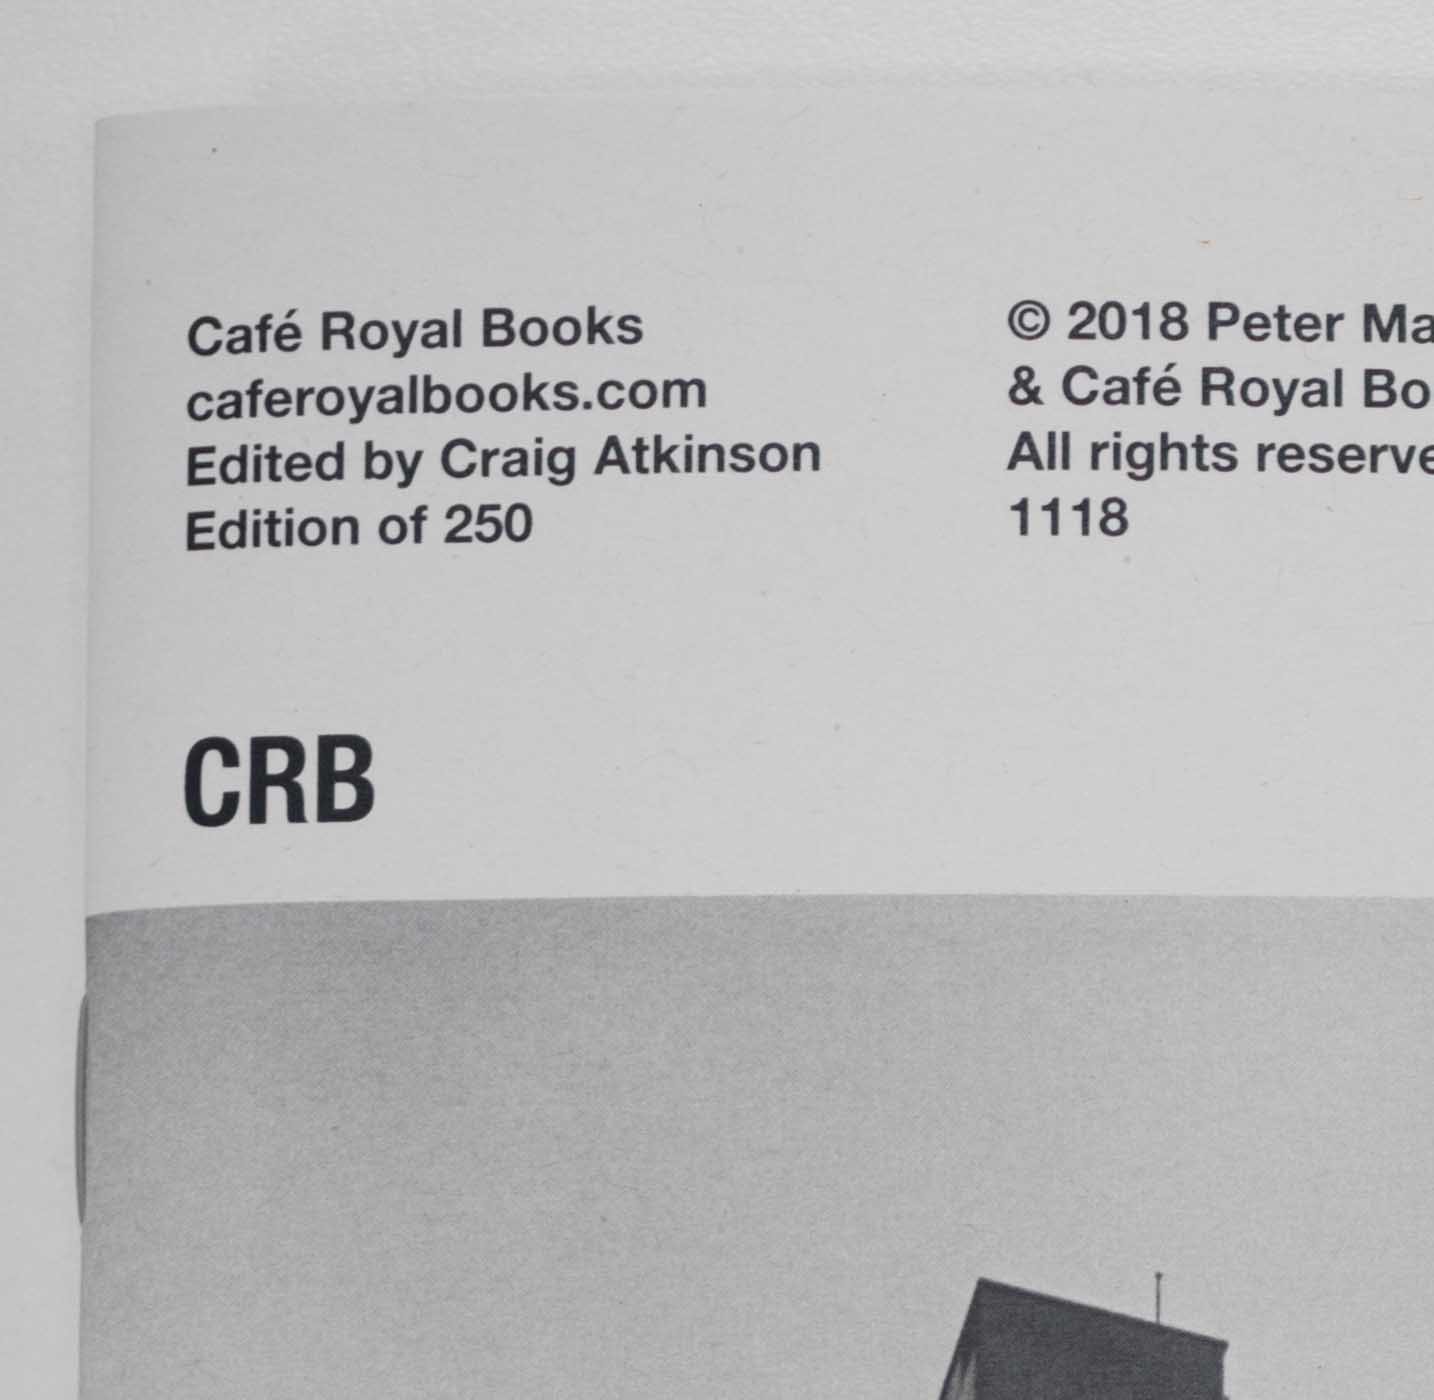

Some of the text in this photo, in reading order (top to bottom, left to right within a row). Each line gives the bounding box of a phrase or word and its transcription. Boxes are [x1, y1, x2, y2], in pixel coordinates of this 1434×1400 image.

[186, 304, 644, 360] Café Royal Books
[1007, 299, 1051, 342] ©
[1067, 299, 1190, 342] 2018
[1207, 300, 1346, 343] Peter
[186, 371, 707, 425] caferoyalbooks.com
[1007, 364, 1045, 407] &
[1061, 361, 1182, 407] Café
[1200, 365, 1344, 417] Royal
[186, 433, 821, 490] Edited by Craig Atkinson
[1006, 430, 1071, 472] All
[1090, 430, 1239, 482] rights
[185, 501, 534, 552] Edition of 250
[1009, 496, 1129, 538] 1118
[183, 735, 375, 828] CRB
